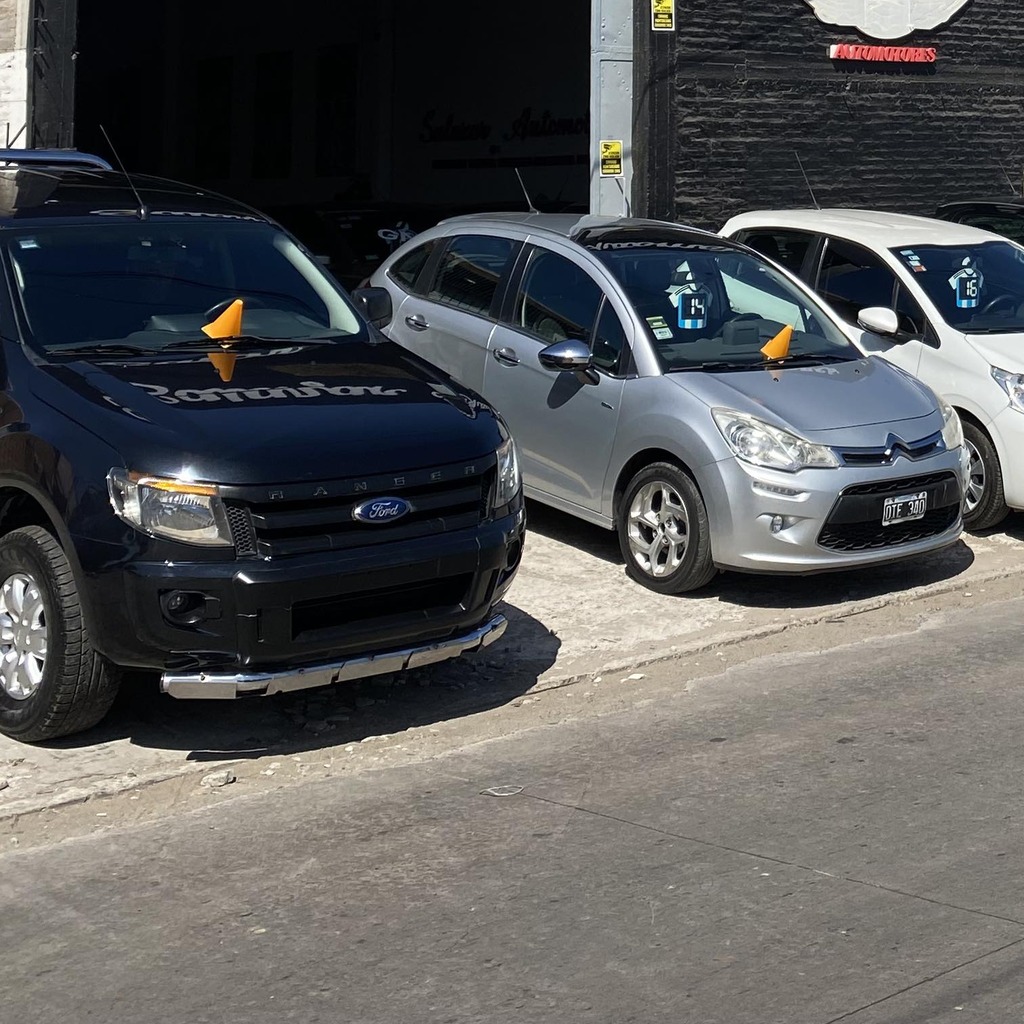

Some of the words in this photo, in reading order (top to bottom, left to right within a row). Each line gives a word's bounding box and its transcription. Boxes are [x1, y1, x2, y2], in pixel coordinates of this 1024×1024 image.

[966, 279, 978, 297] 16
[691, 298, 705, 315] 14
[368, 501, 399, 520] Ford
